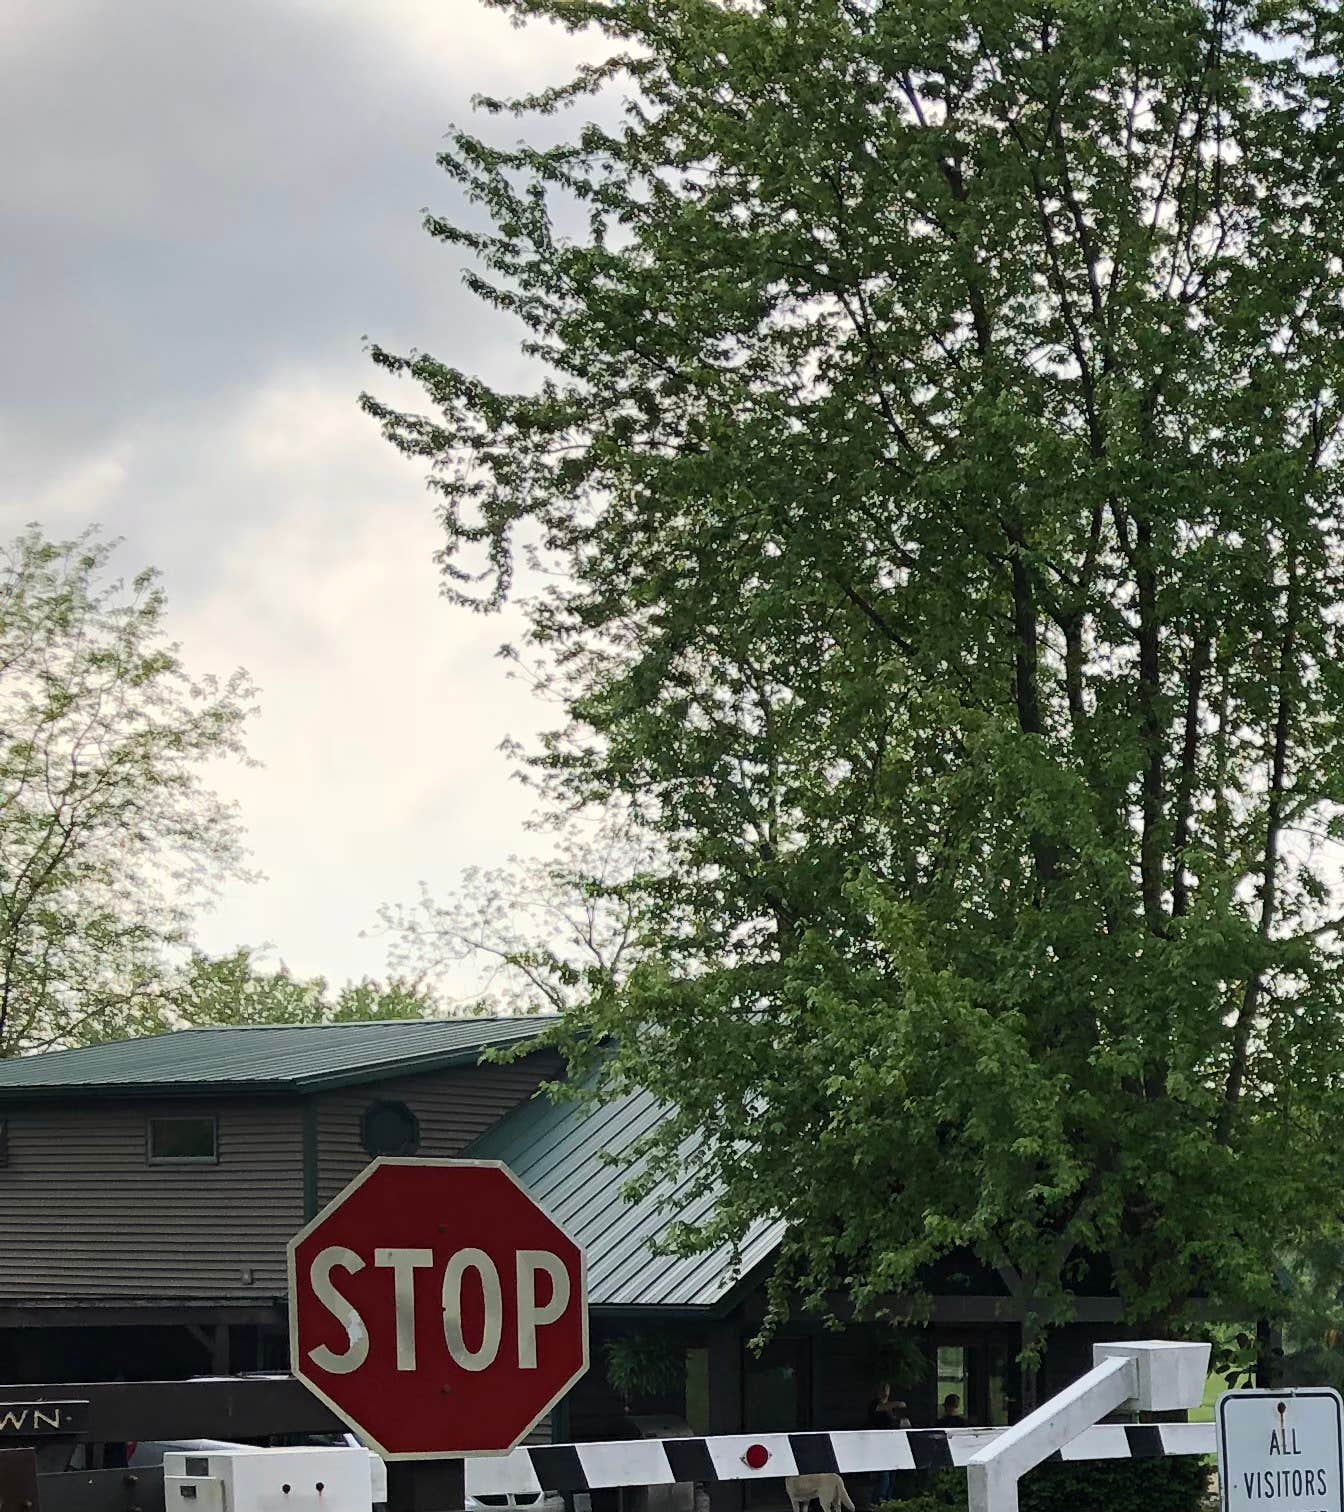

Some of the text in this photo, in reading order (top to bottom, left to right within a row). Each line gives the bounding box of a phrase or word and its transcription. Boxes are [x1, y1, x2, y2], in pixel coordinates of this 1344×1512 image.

[307, 1245, 571, 1374] STOP
[1269, 1428, 1302, 1456] ALL
[1243, 1468, 1327, 1499] VISITORS
